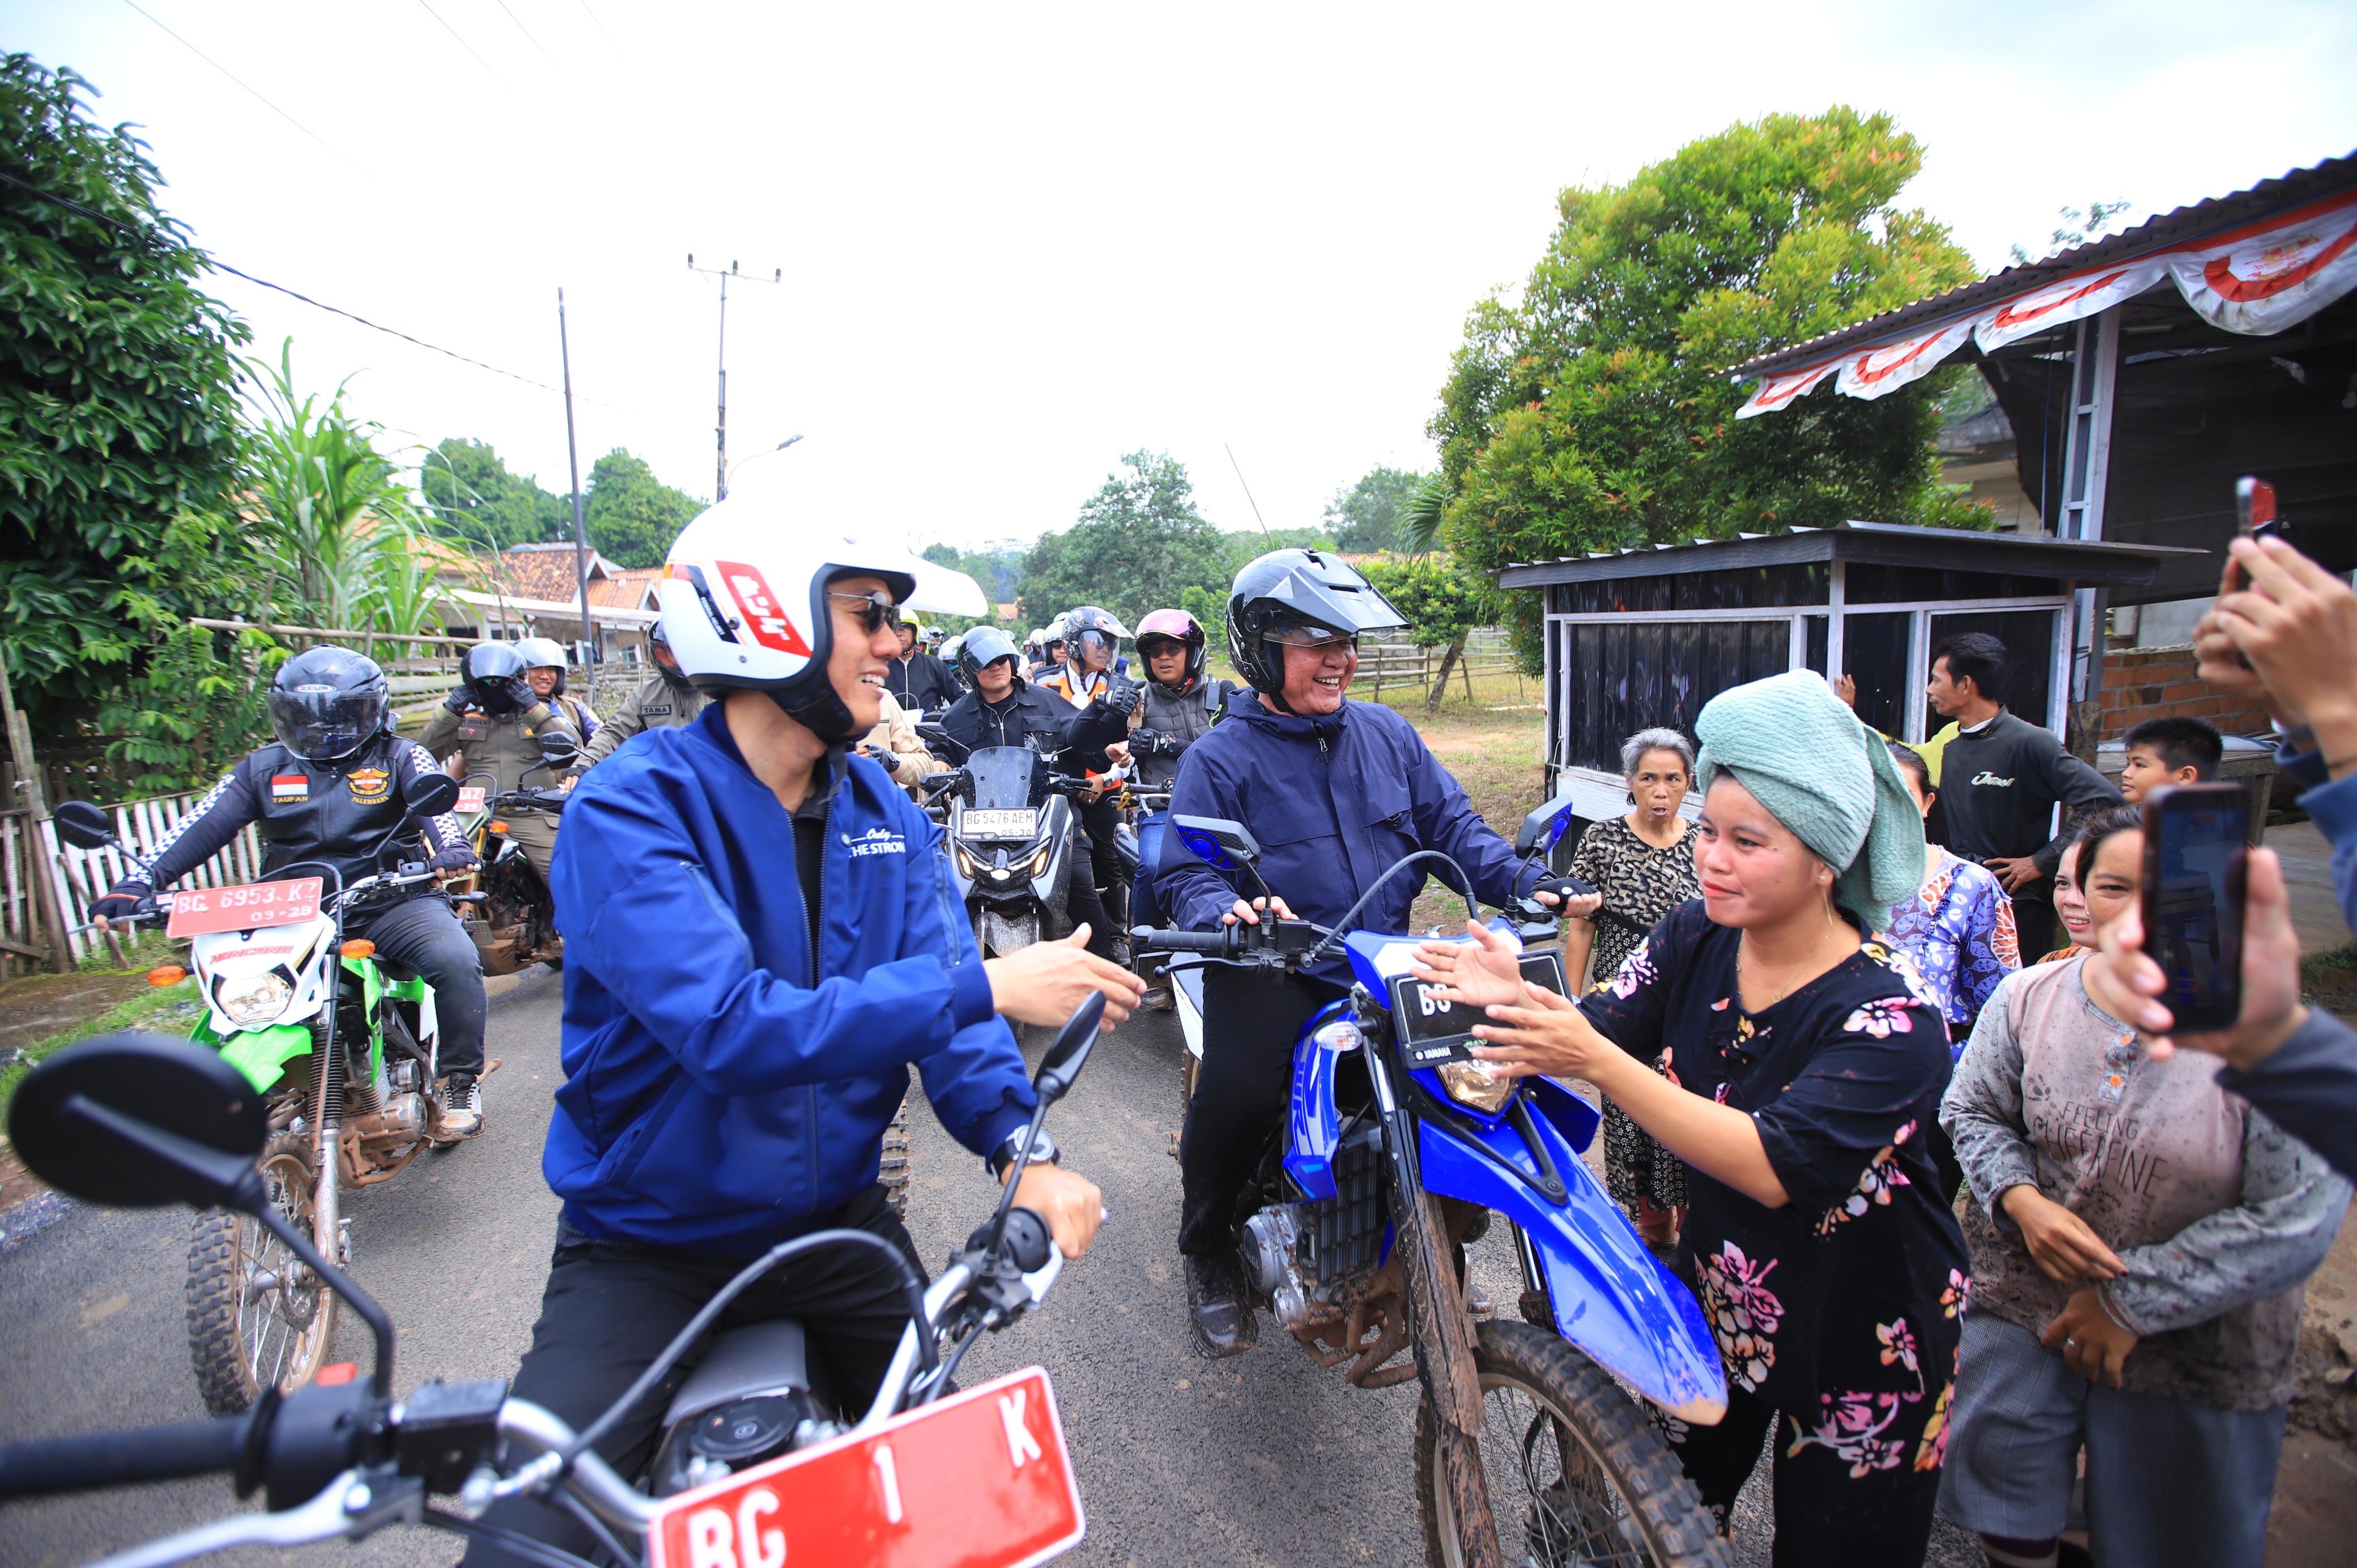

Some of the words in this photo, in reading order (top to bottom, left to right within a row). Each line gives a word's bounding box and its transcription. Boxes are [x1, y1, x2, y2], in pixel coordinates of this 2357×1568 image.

[700, 596, 714, 618] FEDERAL
[711, 617, 725, 635] HELMET
[351, 795, 390, 805] PALEMBANG
[967, 813, 980, 824] BG
[983, 813, 1009, 824] 5476
[1012, 812, 1032, 823] AEM
[866, 828, 891, 841] Only
[177, 894, 208, 914] BG
[220, 887, 276, 908] 6953
[289, 882, 317, 903] KZ
[1423, 1046, 1452, 1060] YAMAHA
[2062, 1101, 2139, 1140] FEELING
[688, 1489, 788, 1568] BG
[873, 1445, 903, 1524] 1
[999, 1388, 1042, 1468] K
